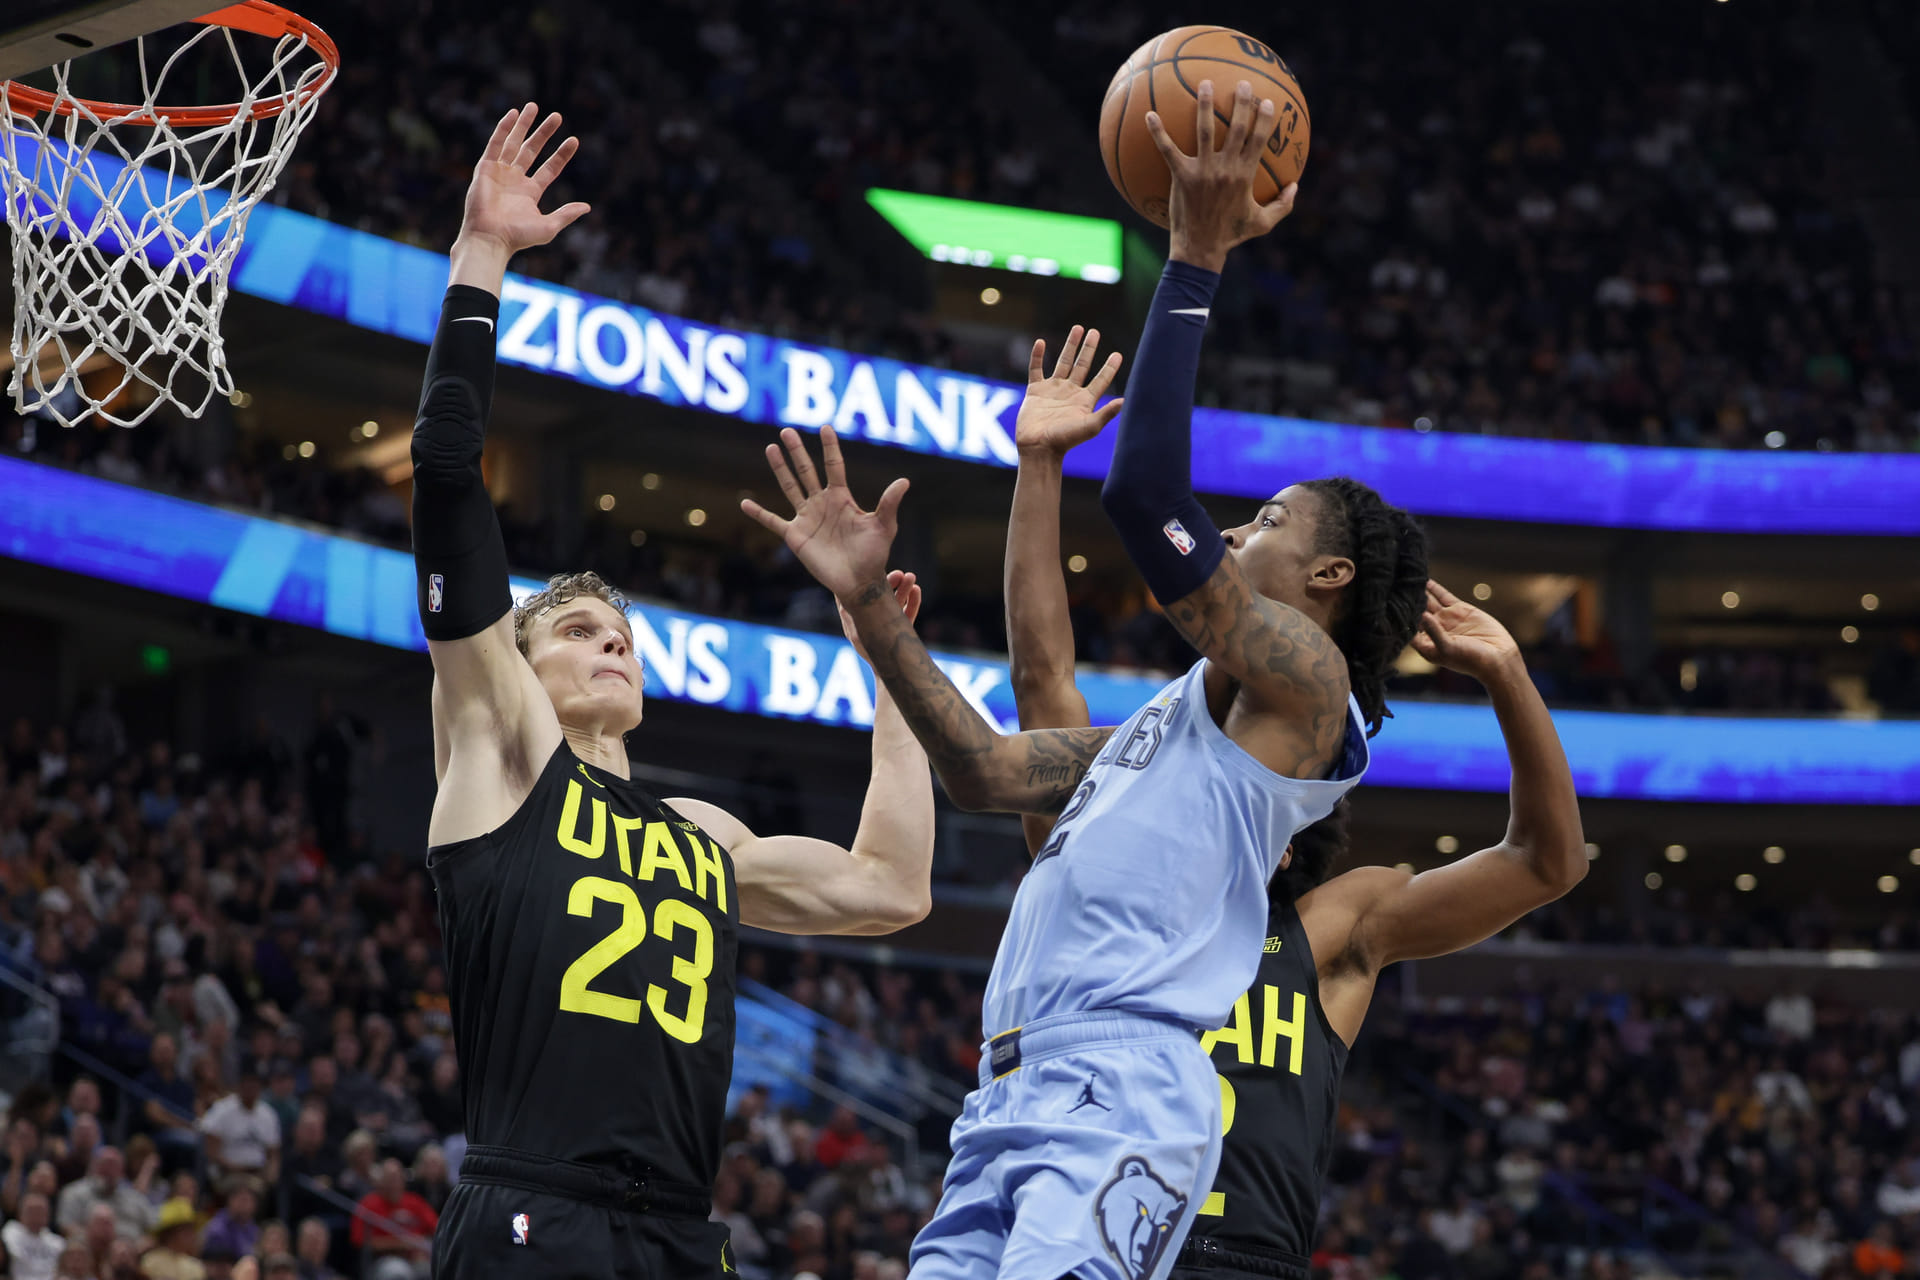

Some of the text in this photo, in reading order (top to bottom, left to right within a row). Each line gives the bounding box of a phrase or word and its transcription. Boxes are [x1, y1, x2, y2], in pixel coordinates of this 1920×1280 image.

[499, 277, 1019, 467] ZIONS BANK
[766, 632, 1007, 736] BAK
[556, 777, 728, 915] UTAH
[559, 875, 714, 1044] 23
[1199, 984, 1307, 1076] AH
